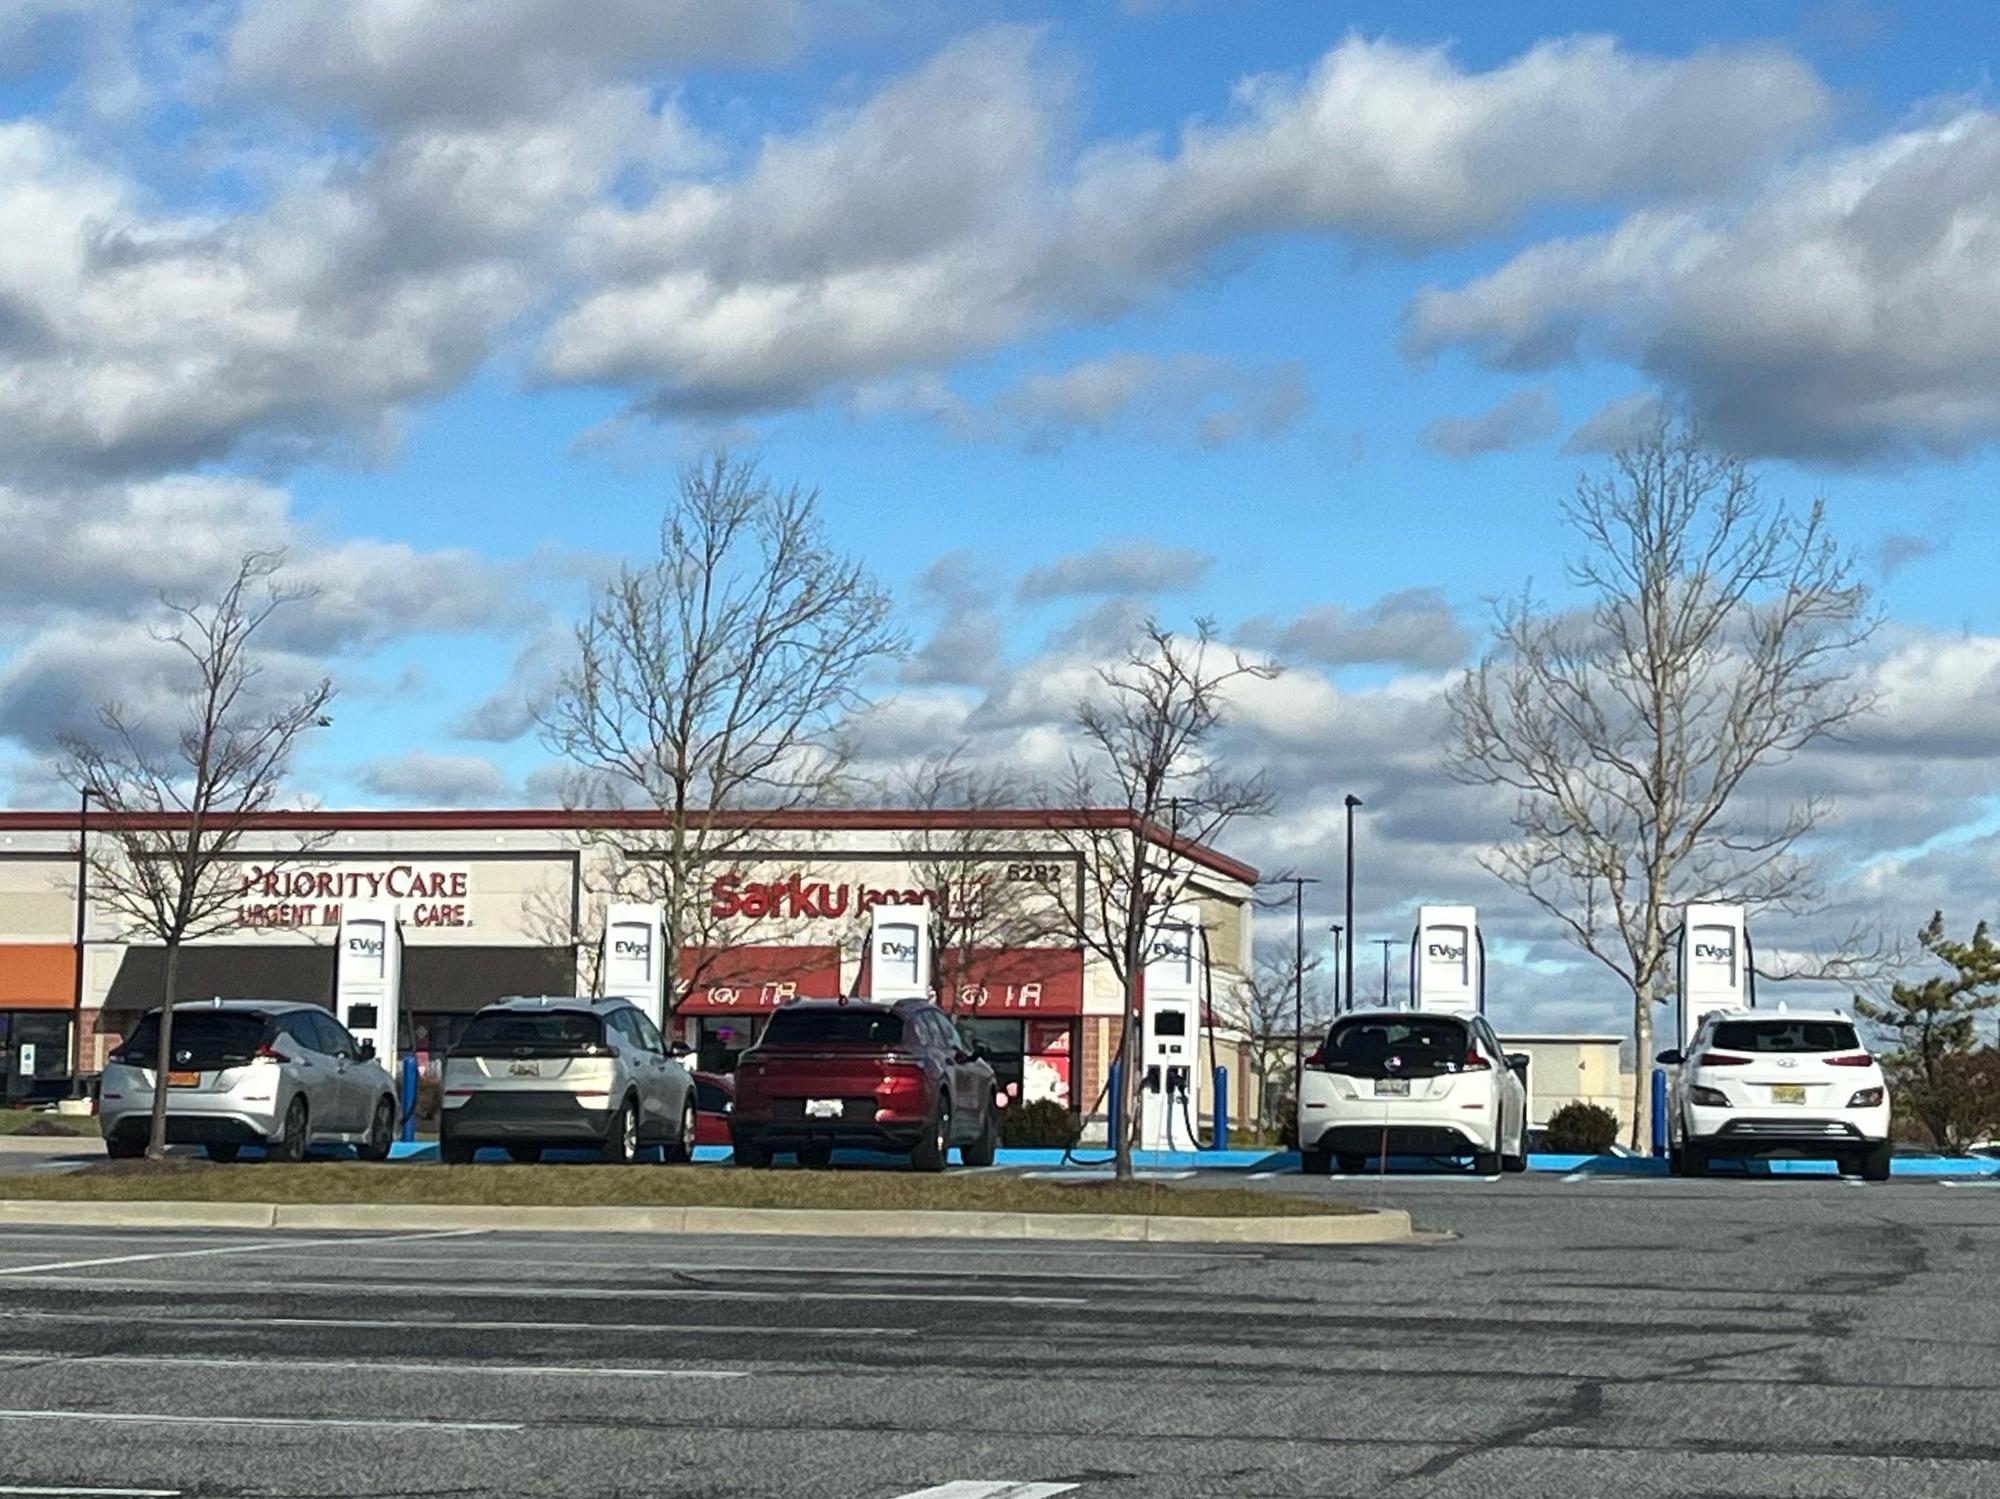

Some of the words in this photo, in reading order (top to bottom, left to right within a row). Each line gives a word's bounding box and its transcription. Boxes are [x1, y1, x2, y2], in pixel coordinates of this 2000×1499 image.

[710, 872, 849, 919] Sarku
[238, 904, 316, 927] URGENT
[413, 903, 465, 927] CARE
[349, 938, 385, 954] EVgo
[615, 941, 650, 957] EVgo
[881, 942, 916, 958] EVgo
[1428, 944, 1465, 960] EVgo
[1695, 944, 1733, 960] EVgo
